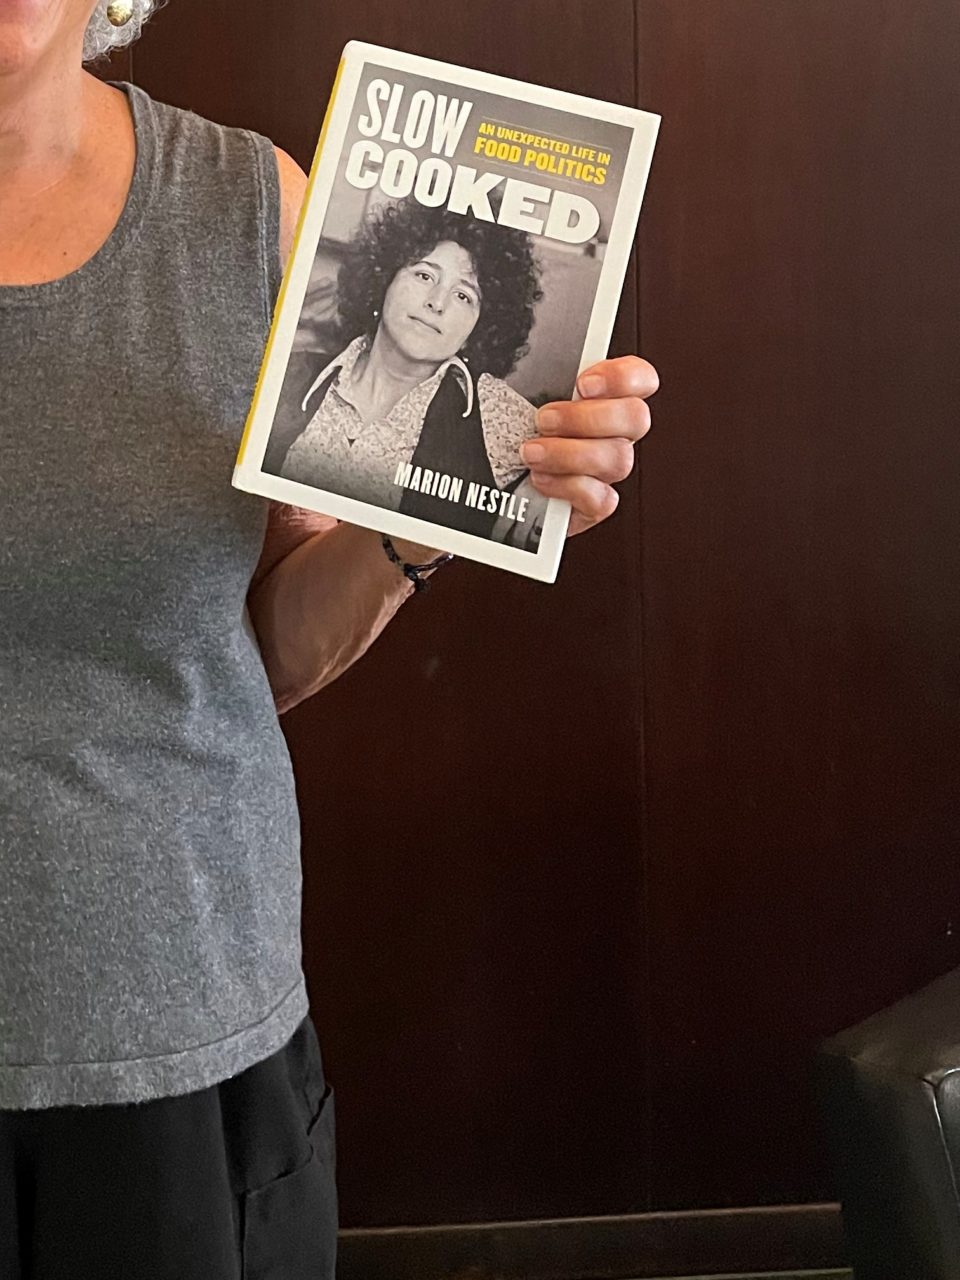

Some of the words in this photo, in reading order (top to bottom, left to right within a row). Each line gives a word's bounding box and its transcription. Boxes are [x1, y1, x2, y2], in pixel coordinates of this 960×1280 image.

[357, 78, 473, 158] SLOW
[478, 122, 495, 136] AN
[496, 126, 570, 155] UNEXPECTED
[571, 145, 596, 162] LIFE
[597, 152, 611, 165] IN
[473, 136, 522, 163] FOOD
[523, 149, 607, 185] POLITICS
[343, 140, 601, 245] COOKED
[393, 461, 464, 503] MARION
[465, 481, 529, 523] NESTLE
